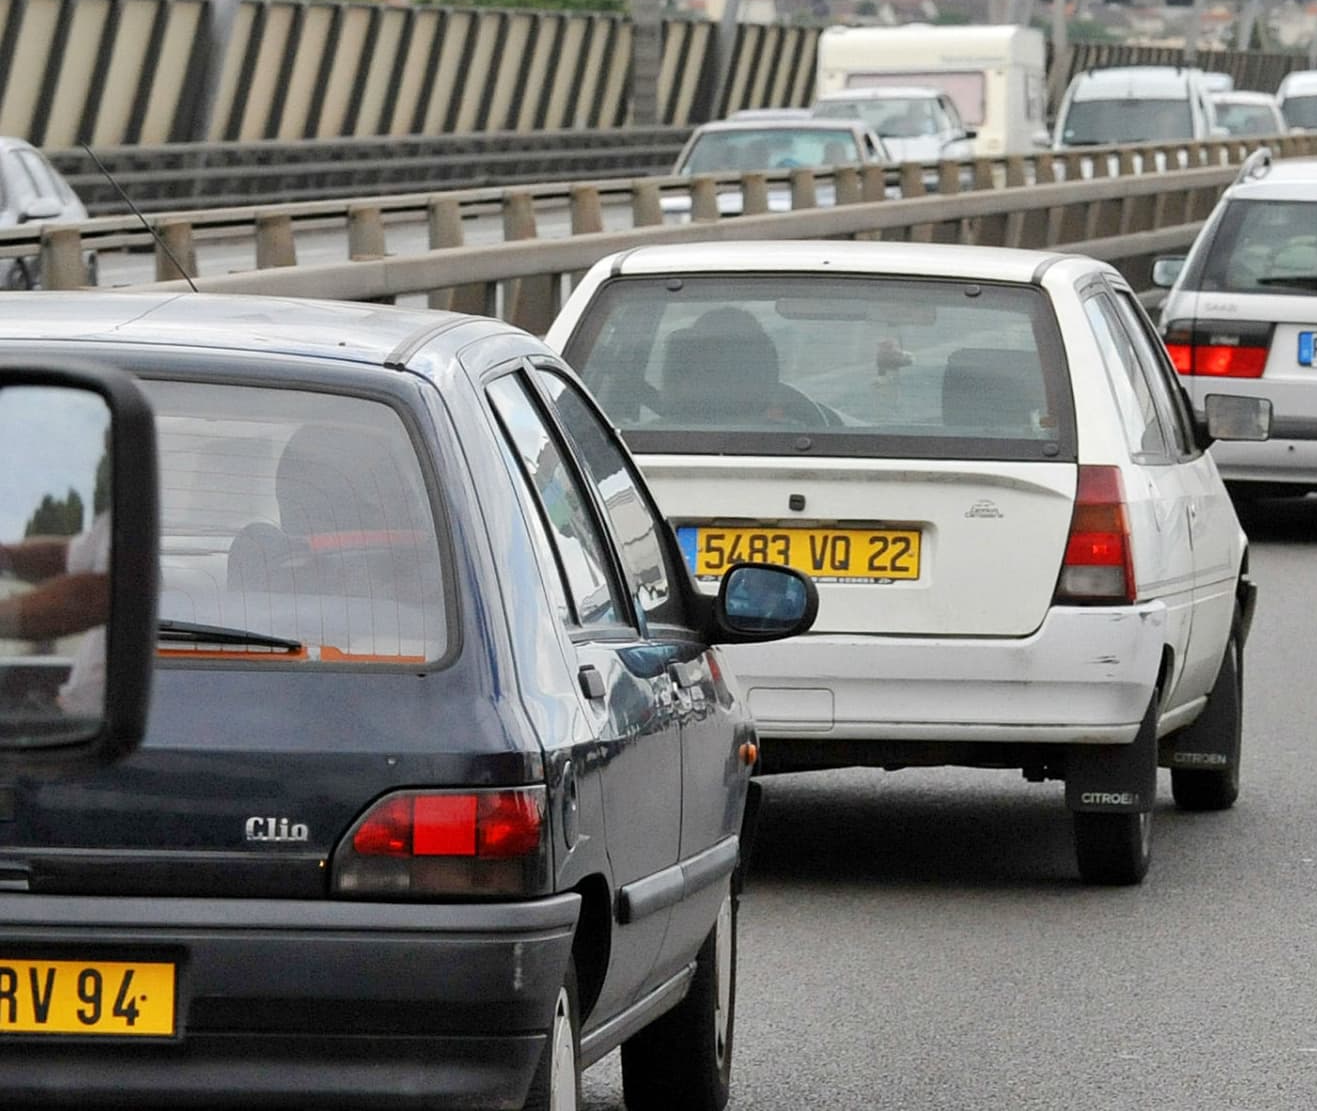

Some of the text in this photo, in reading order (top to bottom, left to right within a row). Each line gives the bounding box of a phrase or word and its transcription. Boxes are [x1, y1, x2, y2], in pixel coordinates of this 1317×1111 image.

[704, 534, 911, 572] 5483 VQ 22
[246, 816, 309, 842] Clio
[76, 967, 140, 1027] 94
